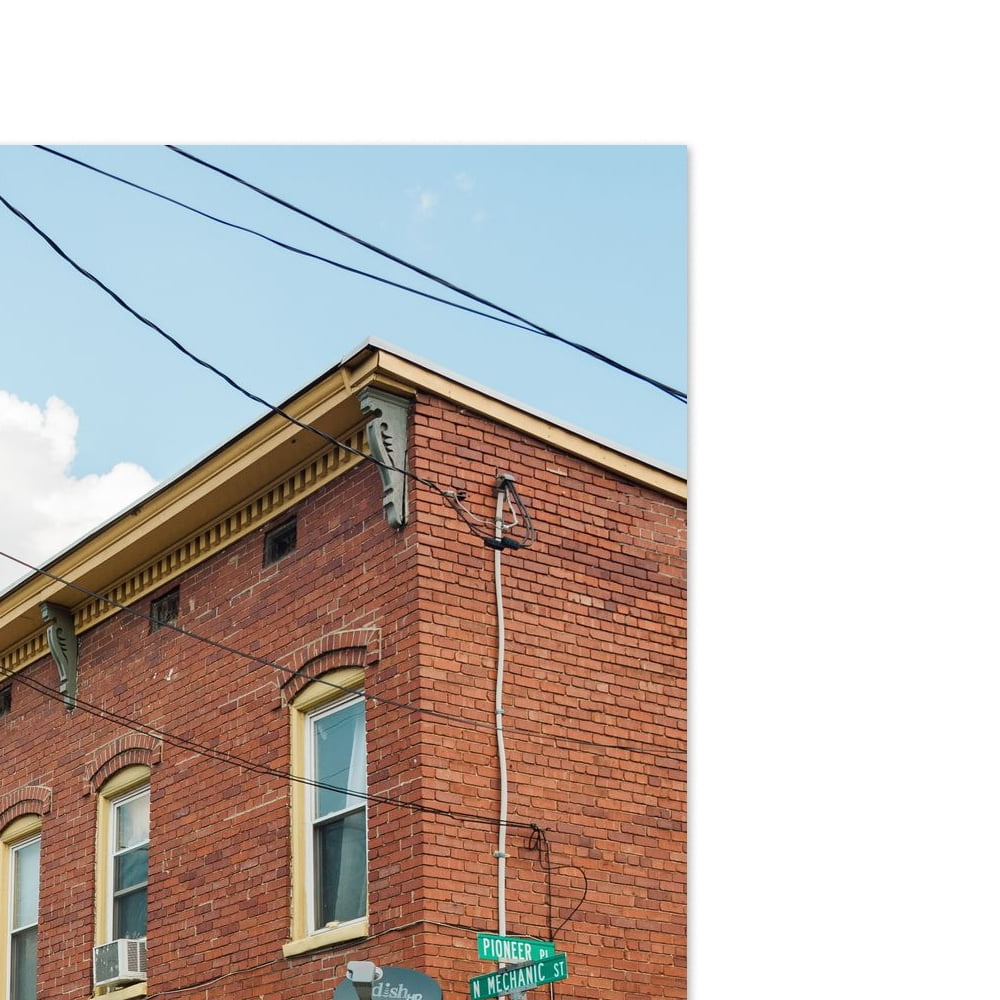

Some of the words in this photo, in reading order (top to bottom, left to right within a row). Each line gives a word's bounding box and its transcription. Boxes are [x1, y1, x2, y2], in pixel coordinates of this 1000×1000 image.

[483, 938, 532, 960] PIONEER
[473, 980, 481, 999] N
[487, 963, 546, 995] MECHANIC
[554, 961, 564, 978] ST
